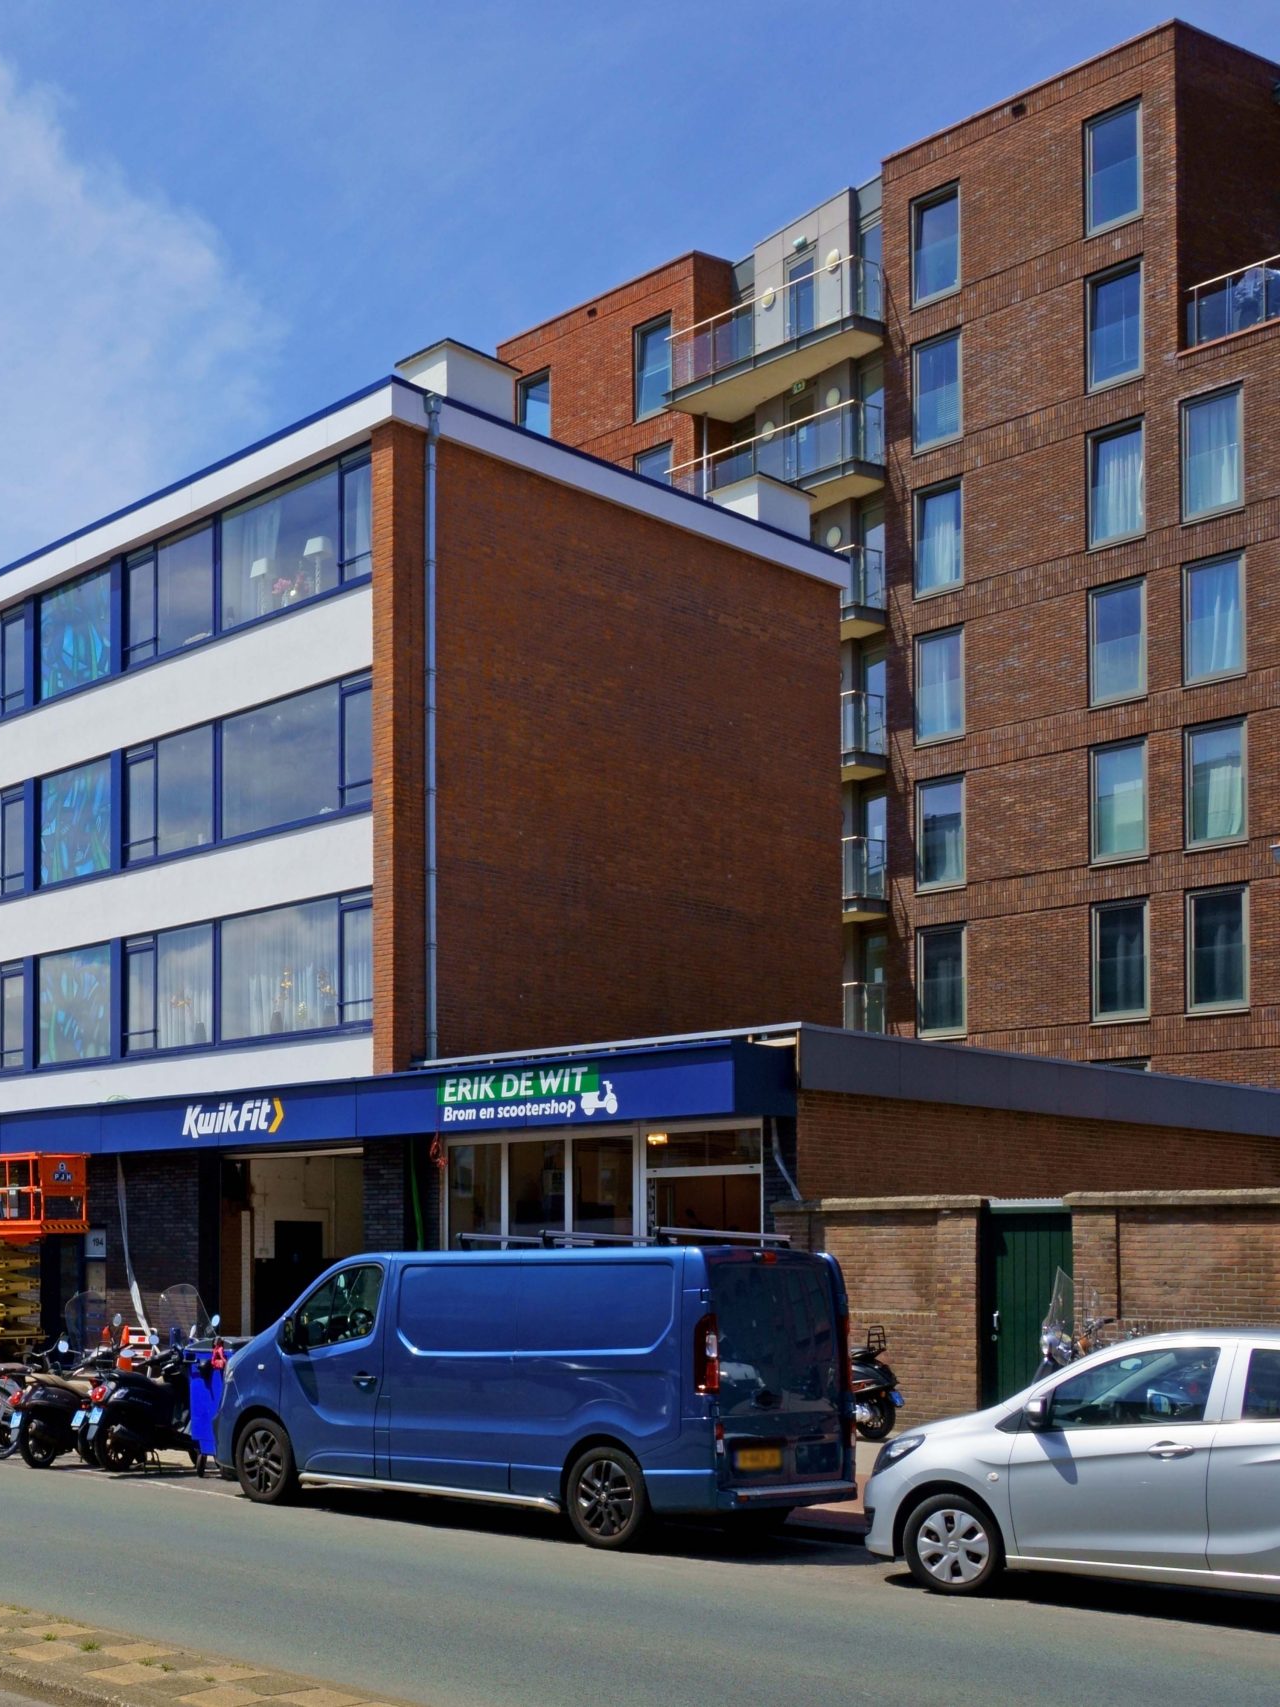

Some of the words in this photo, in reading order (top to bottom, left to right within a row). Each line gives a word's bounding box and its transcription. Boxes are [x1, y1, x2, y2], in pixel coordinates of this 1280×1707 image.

[443, 1075, 497, 1102] ERIK
[501, 1071, 534, 1097] DE
[539, 1066, 588, 1094] WIT
[182, 1098, 271, 1138] KwikFit
[443, 1106, 476, 1122] Brom
[479, 1108, 495, 1119] en
[497, 1099, 576, 1117] scootershop
[92, 1238, 104, 1247] 194
